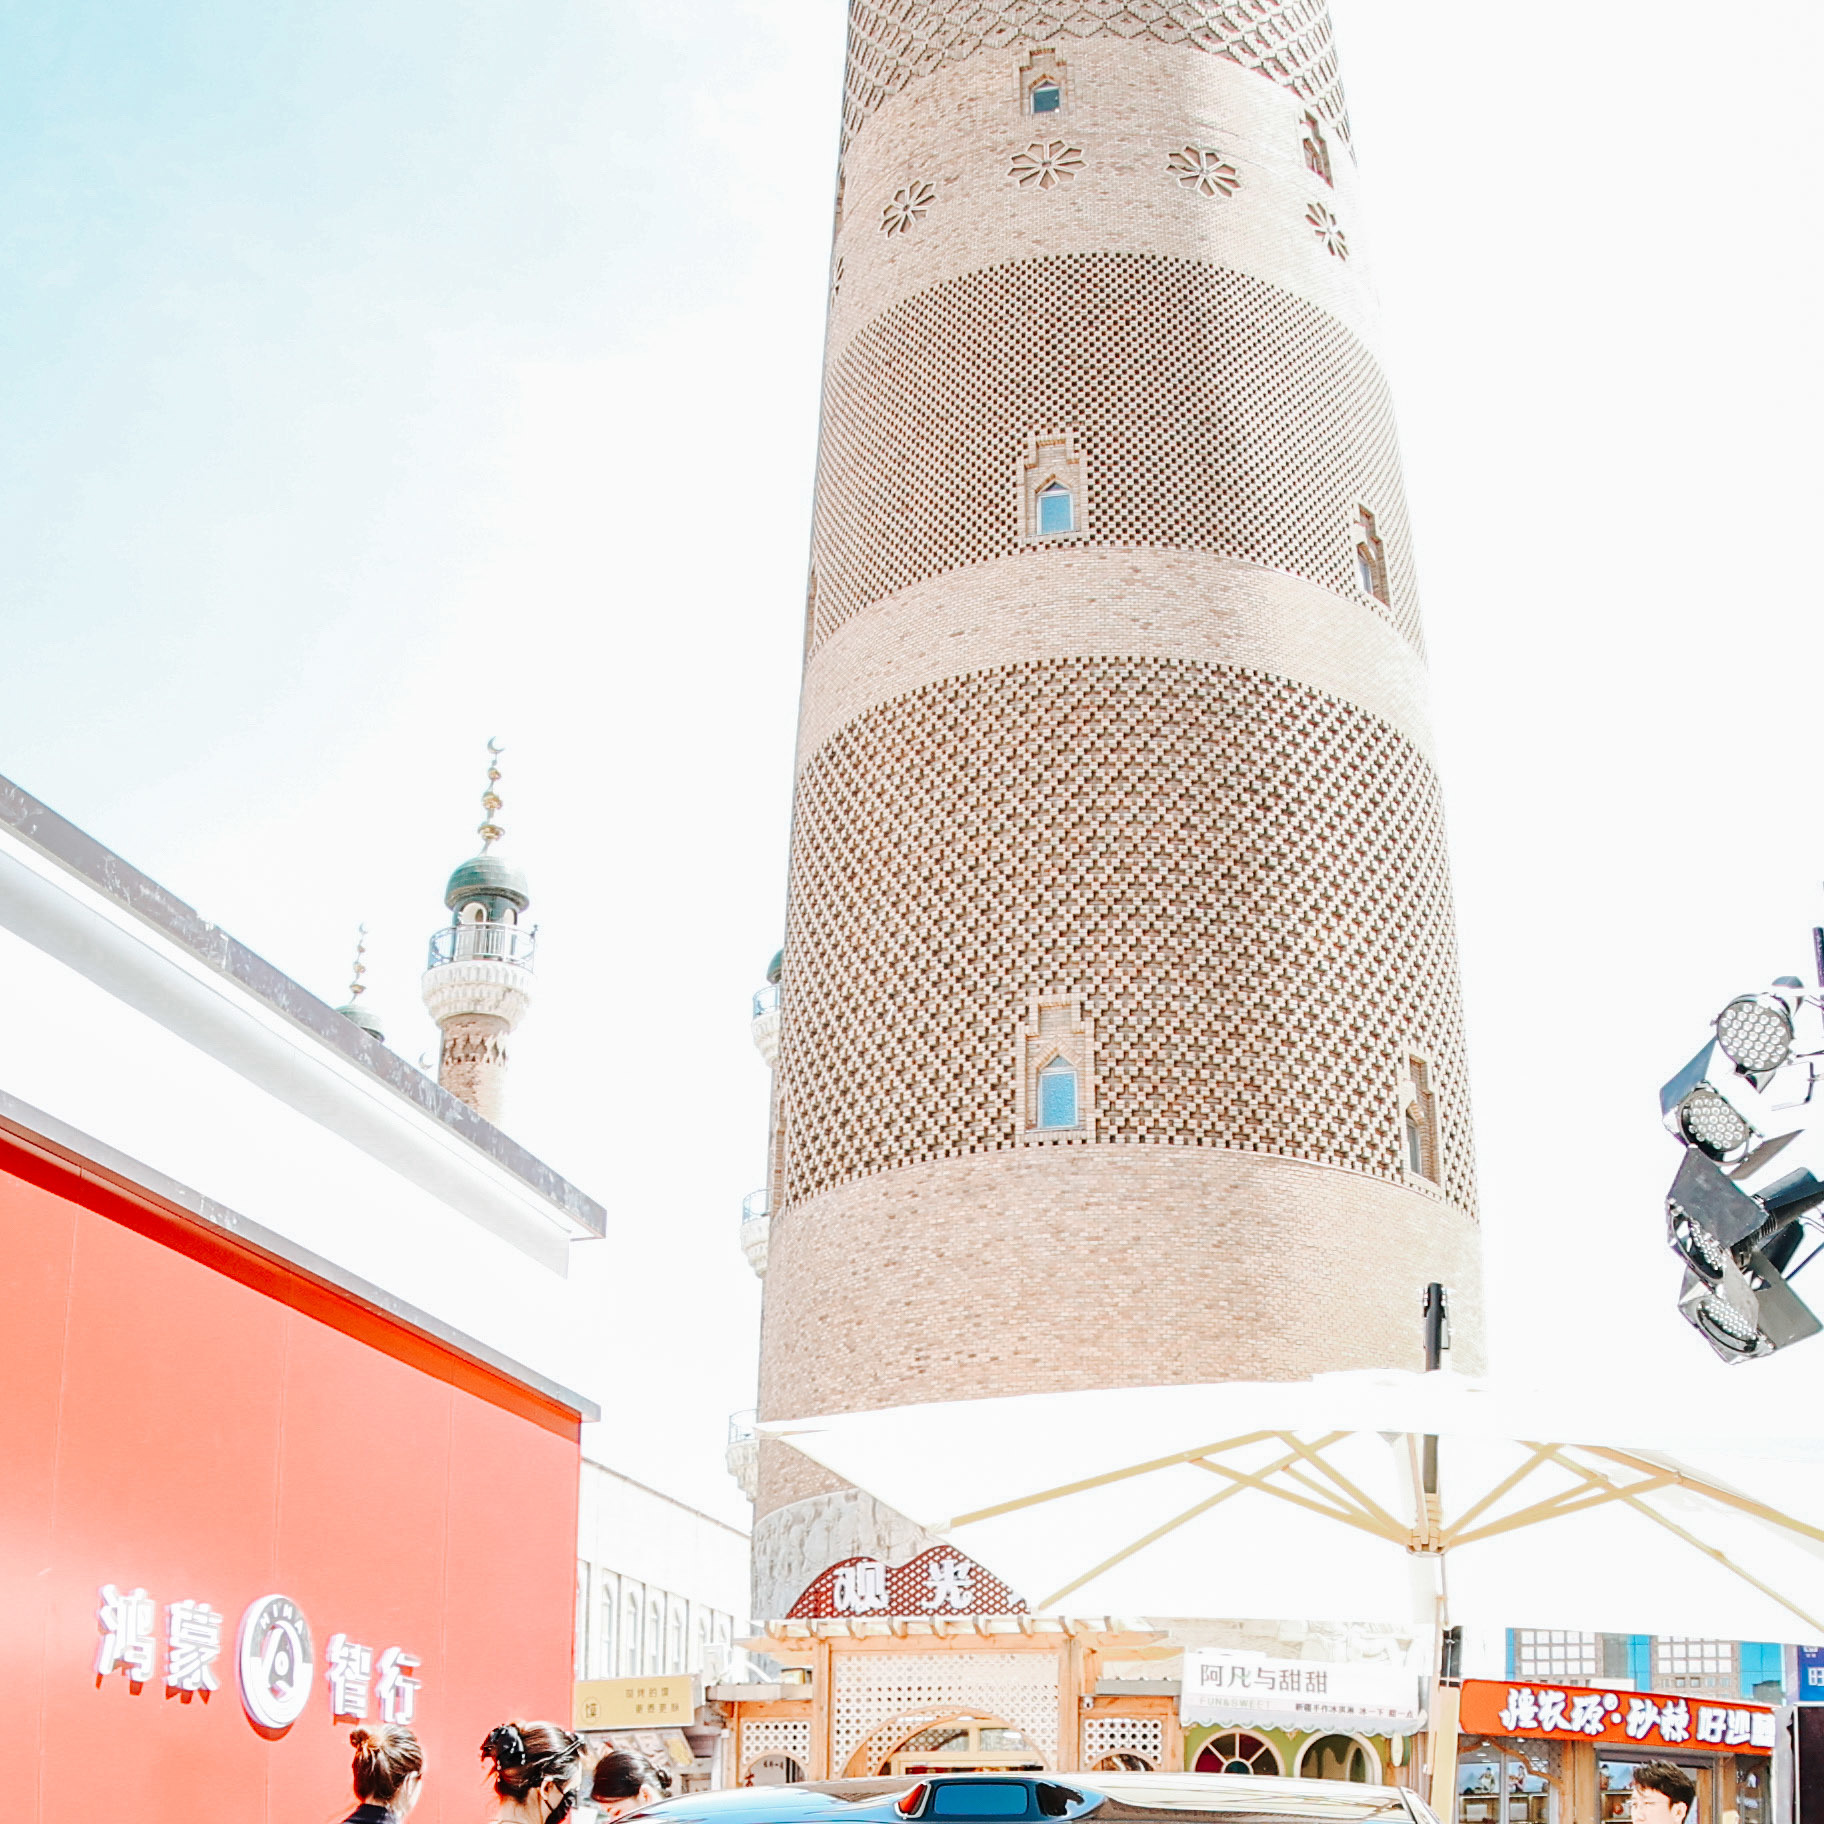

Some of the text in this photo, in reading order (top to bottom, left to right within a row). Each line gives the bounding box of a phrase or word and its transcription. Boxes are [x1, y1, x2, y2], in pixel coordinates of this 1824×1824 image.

[95, 1584, 223, 1692] 鸿蒙
[327, 1633, 422, 1726] 智行
[1200, 1663, 1328, 1694] 阿凡与甜甜
